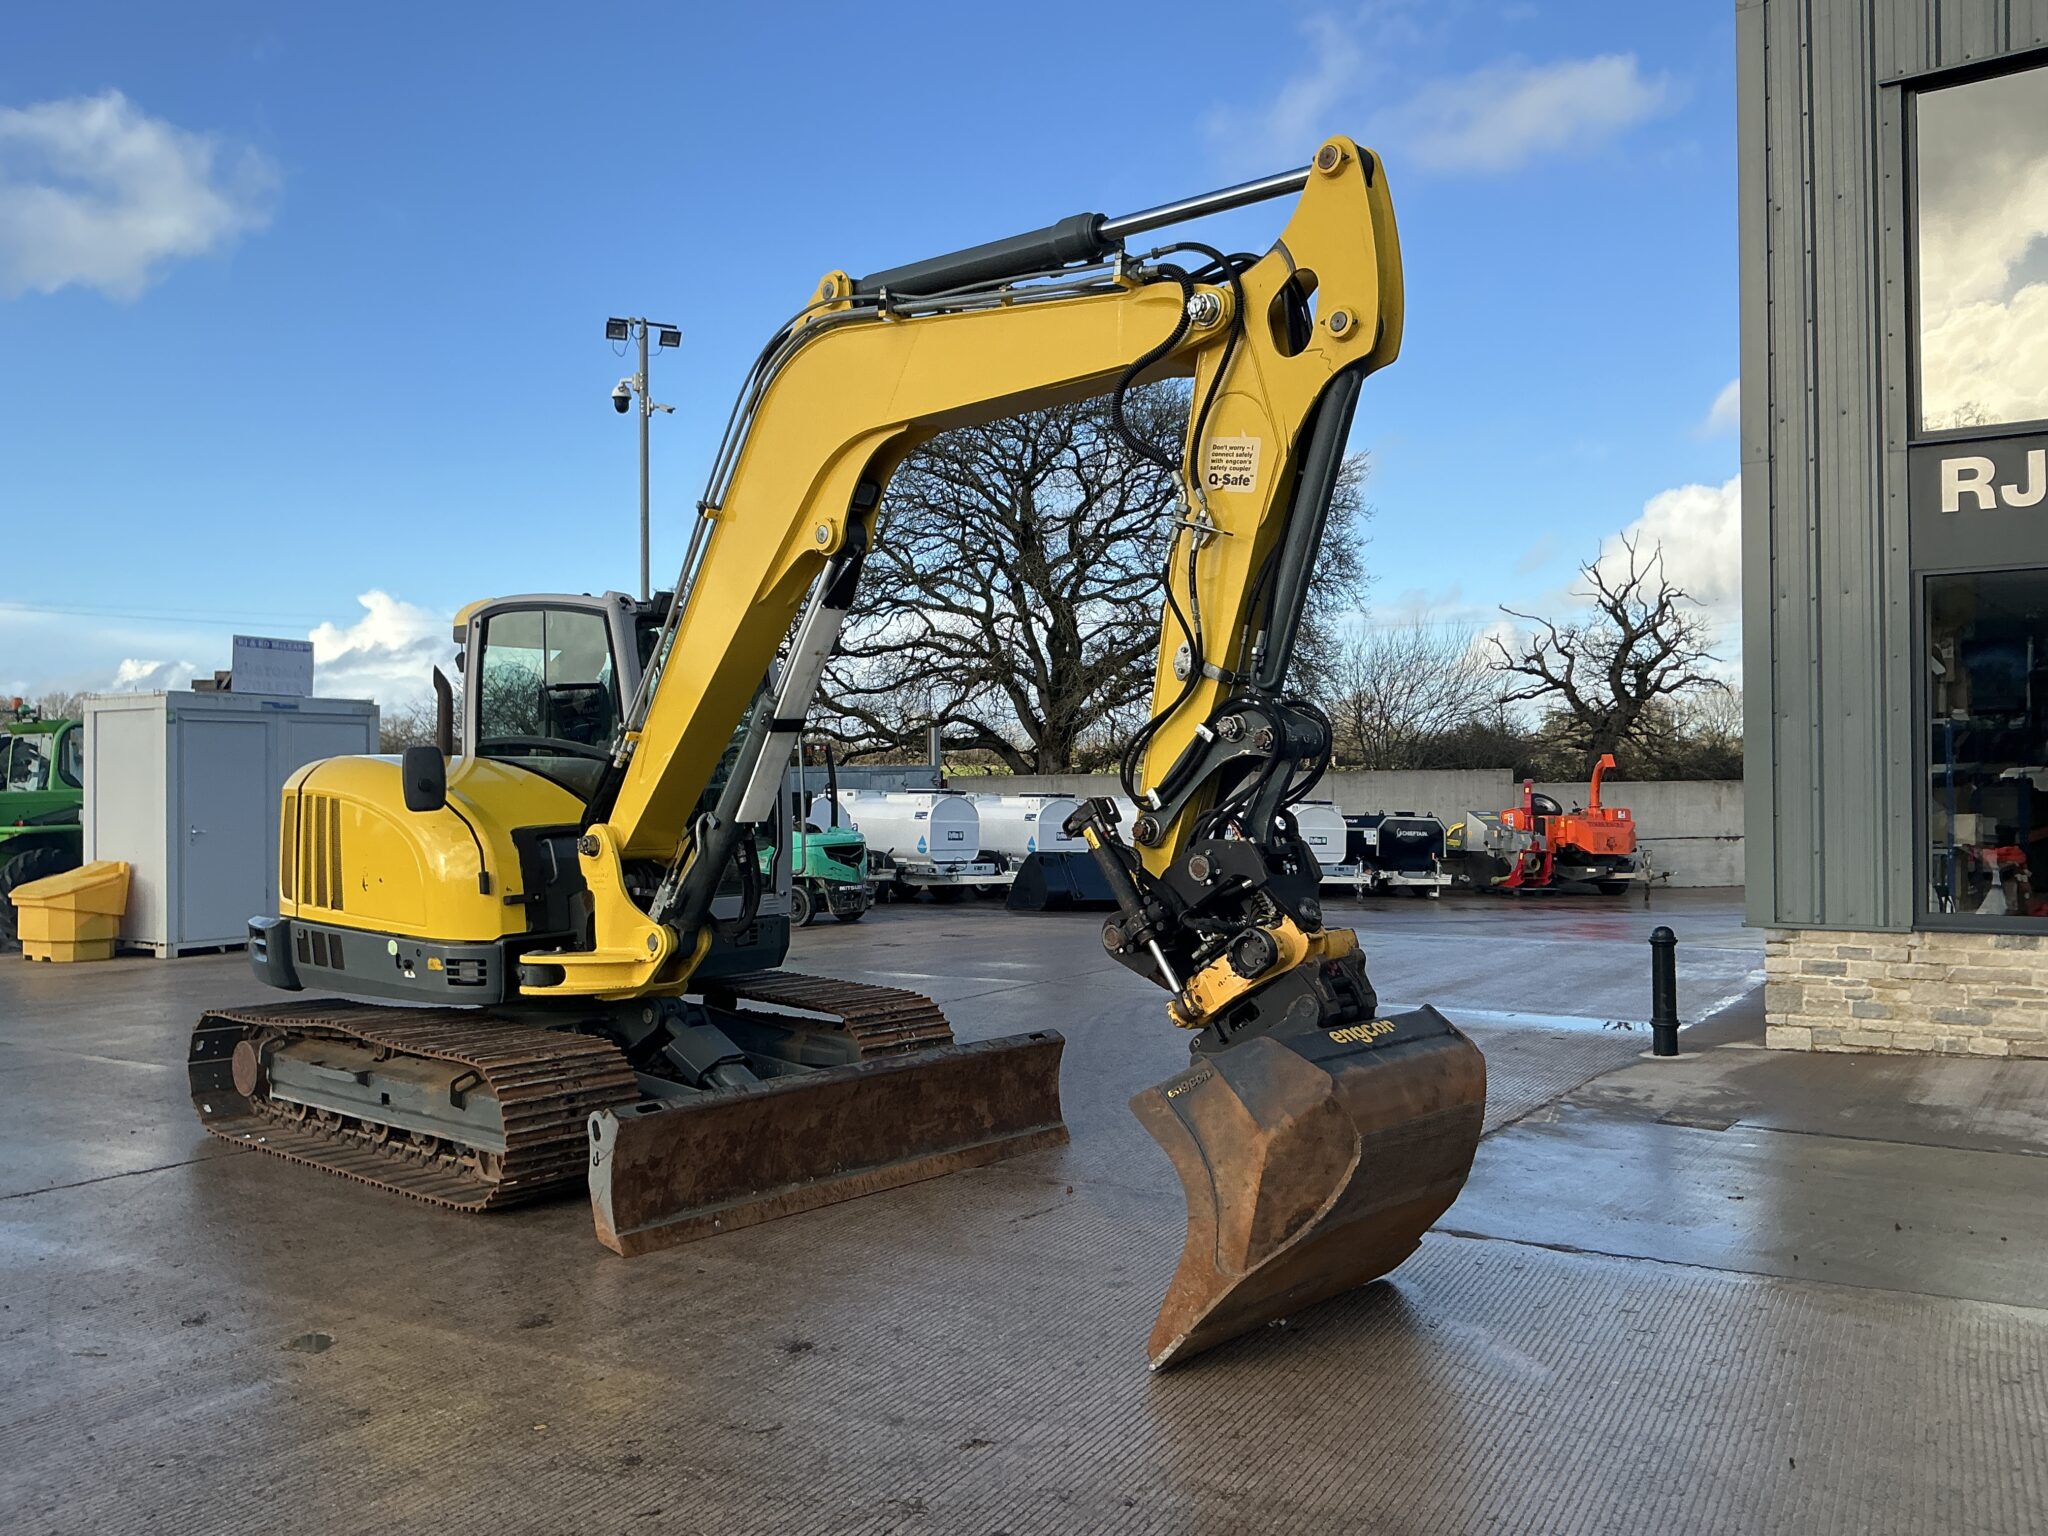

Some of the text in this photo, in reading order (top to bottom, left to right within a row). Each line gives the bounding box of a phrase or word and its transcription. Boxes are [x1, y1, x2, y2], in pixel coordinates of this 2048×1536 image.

[1941, 449, 2047, 513] RJ
[1328, 1019, 1397, 1044] engcon
[1167, 1069, 1214, 1098] engcon
